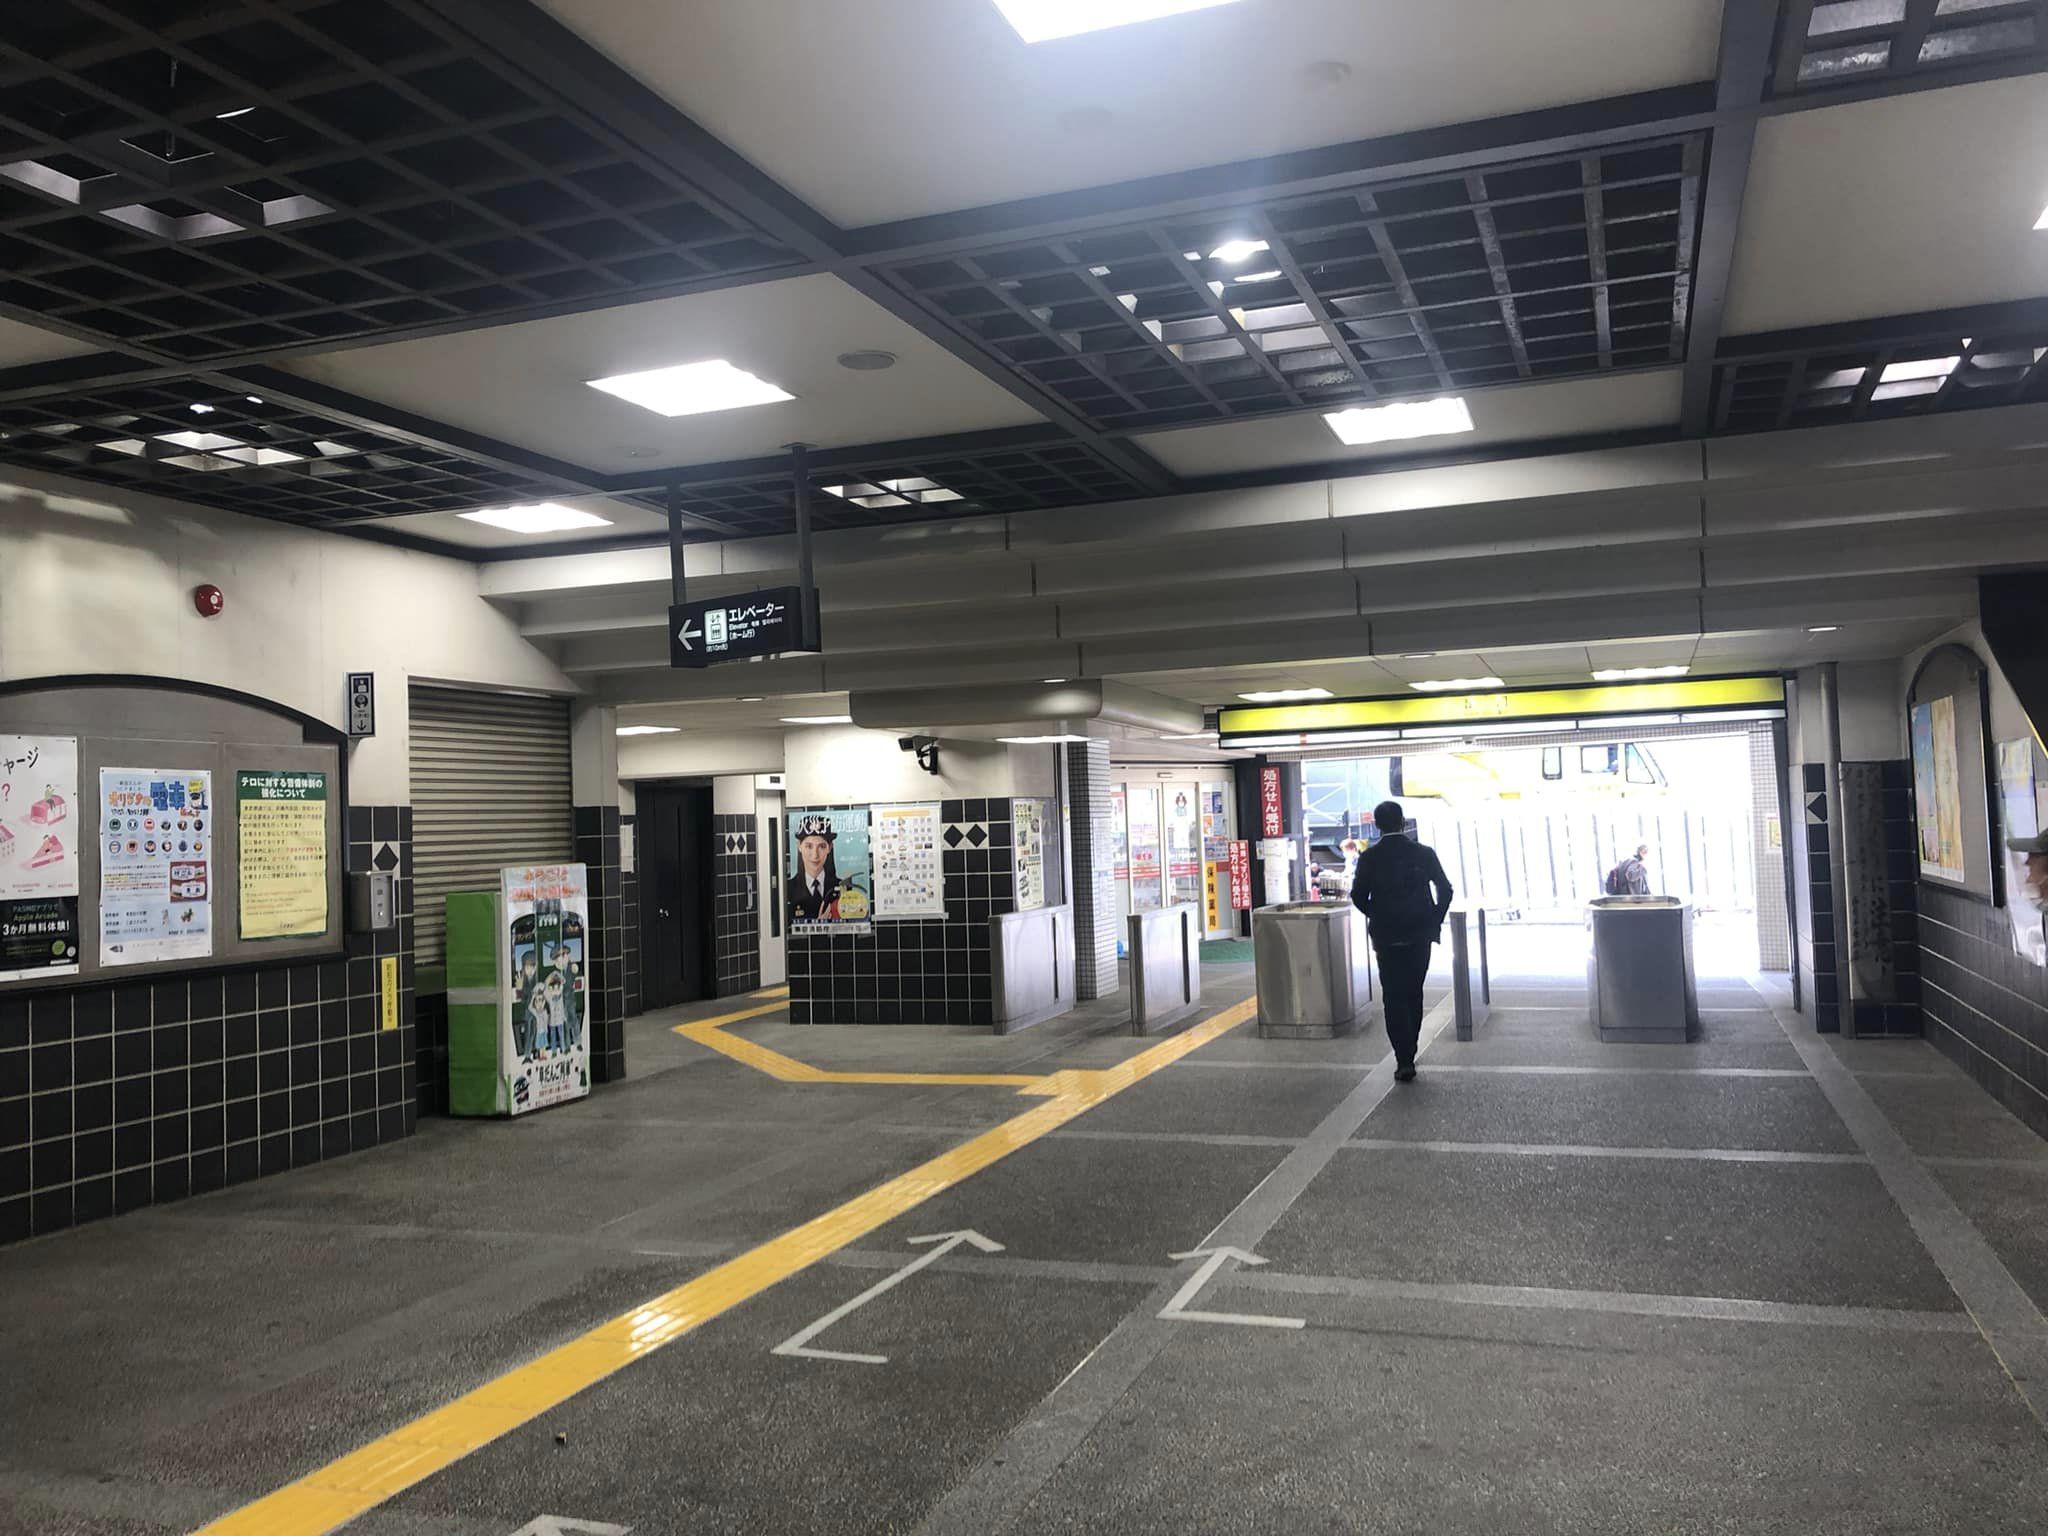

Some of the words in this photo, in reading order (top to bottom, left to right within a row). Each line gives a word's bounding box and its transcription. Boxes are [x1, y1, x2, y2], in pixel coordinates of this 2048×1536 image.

[729, 602, 785, 622] エレベーター
[241, 777, 324, 789] テロに対する警備体制の
[261, 788, 306, 799] 強化について
[1263, 769, 1280, 836] 処方せん受付
[1230, 842, 1241, 908] 処方せん受付
[2, 920, 70, 937] 3か月無料体験!
